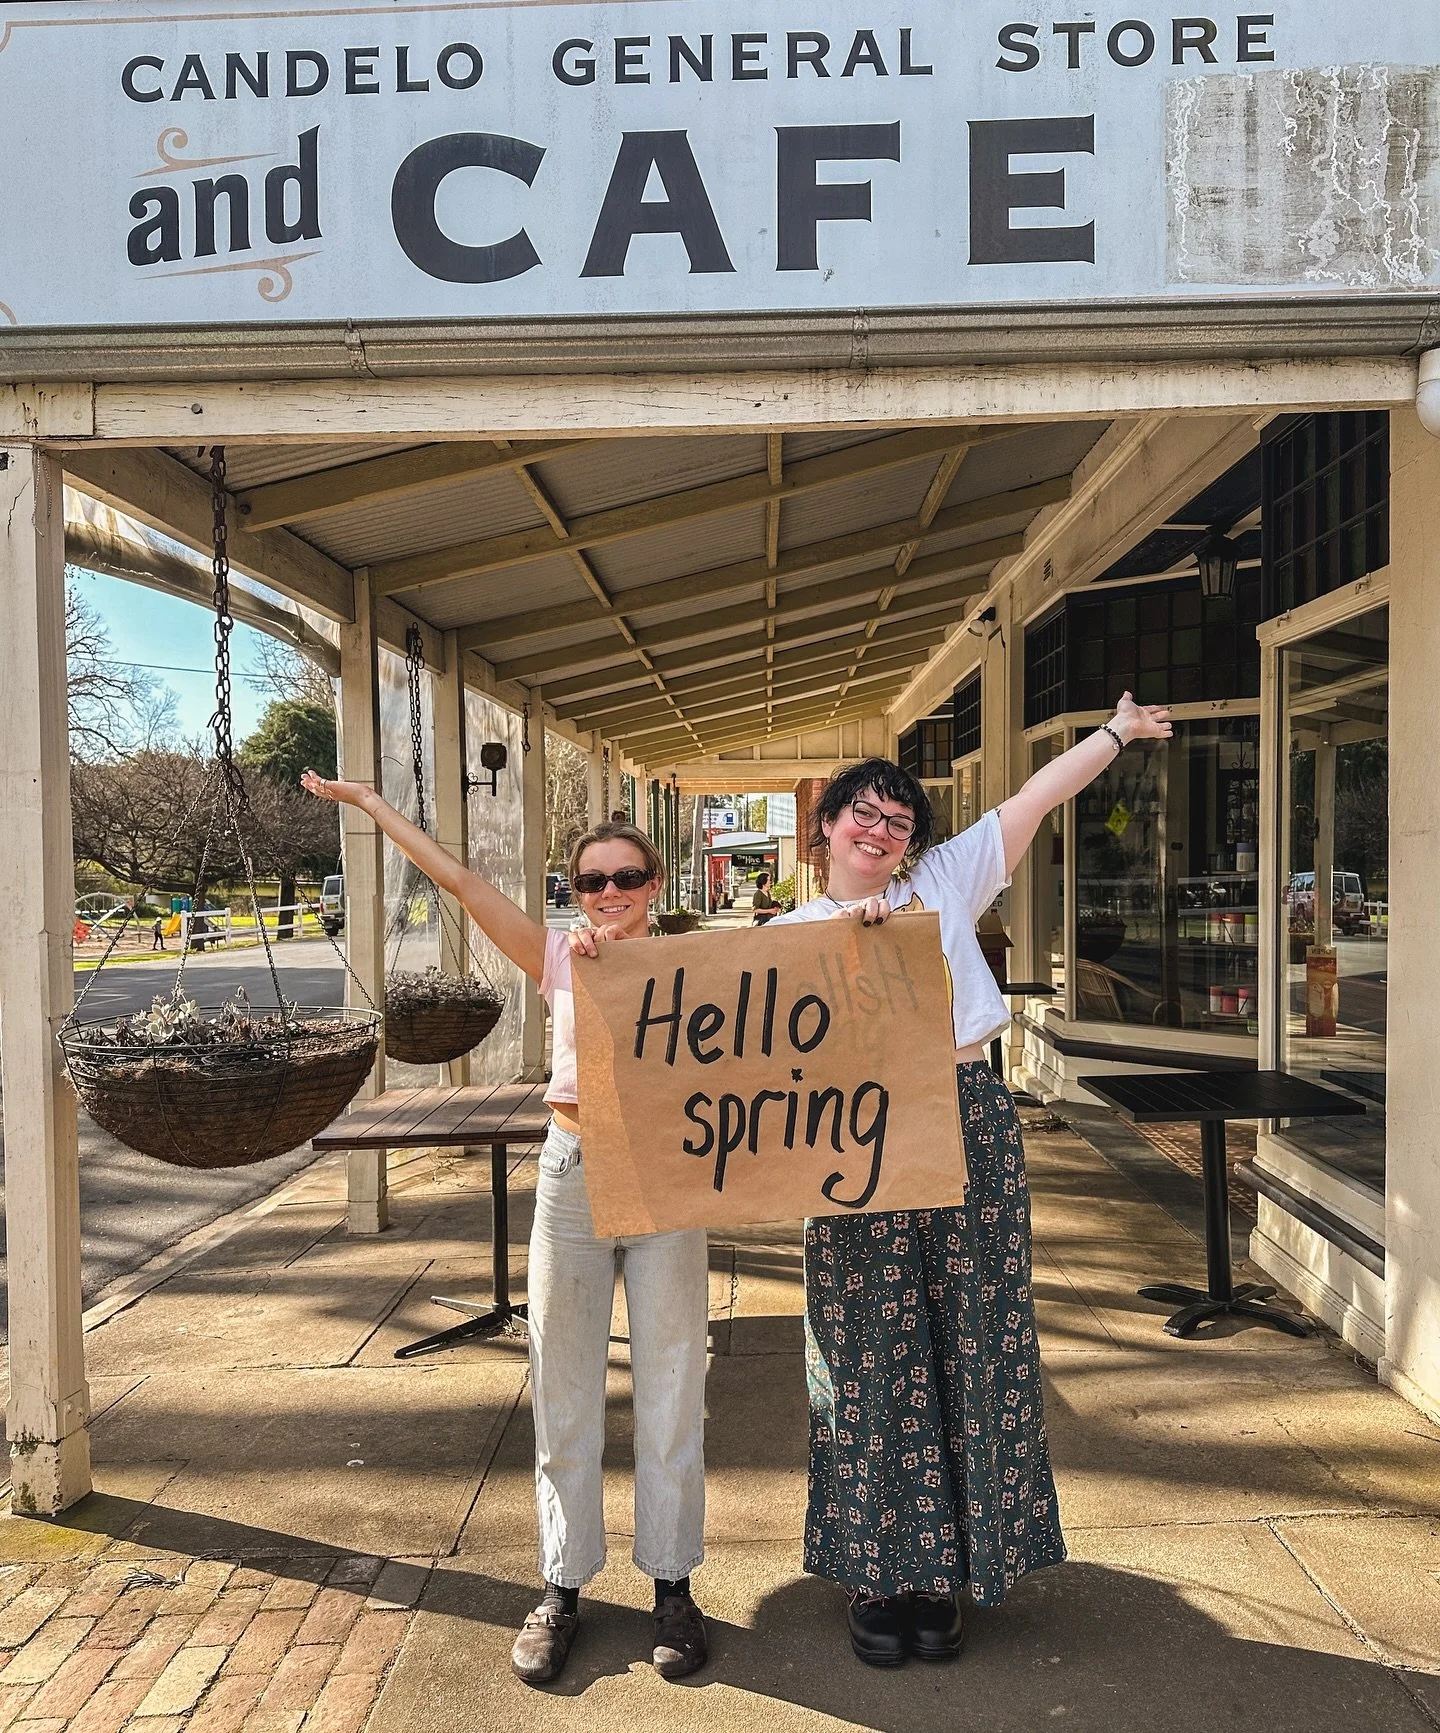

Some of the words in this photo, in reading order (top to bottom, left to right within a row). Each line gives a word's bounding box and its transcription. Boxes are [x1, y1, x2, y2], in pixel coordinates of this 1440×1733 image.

[121, 42, 484, 103] CANDELO
[552, 27, 933, 87] GENERAL
[994, 13, 1275, 73] STORE
[126, 124, 323, 268] and
[390, 113, 1096, 285] CAFE
[635, 967, 831, 1067] Hello
[682, 1067, 889, 1209] spring
